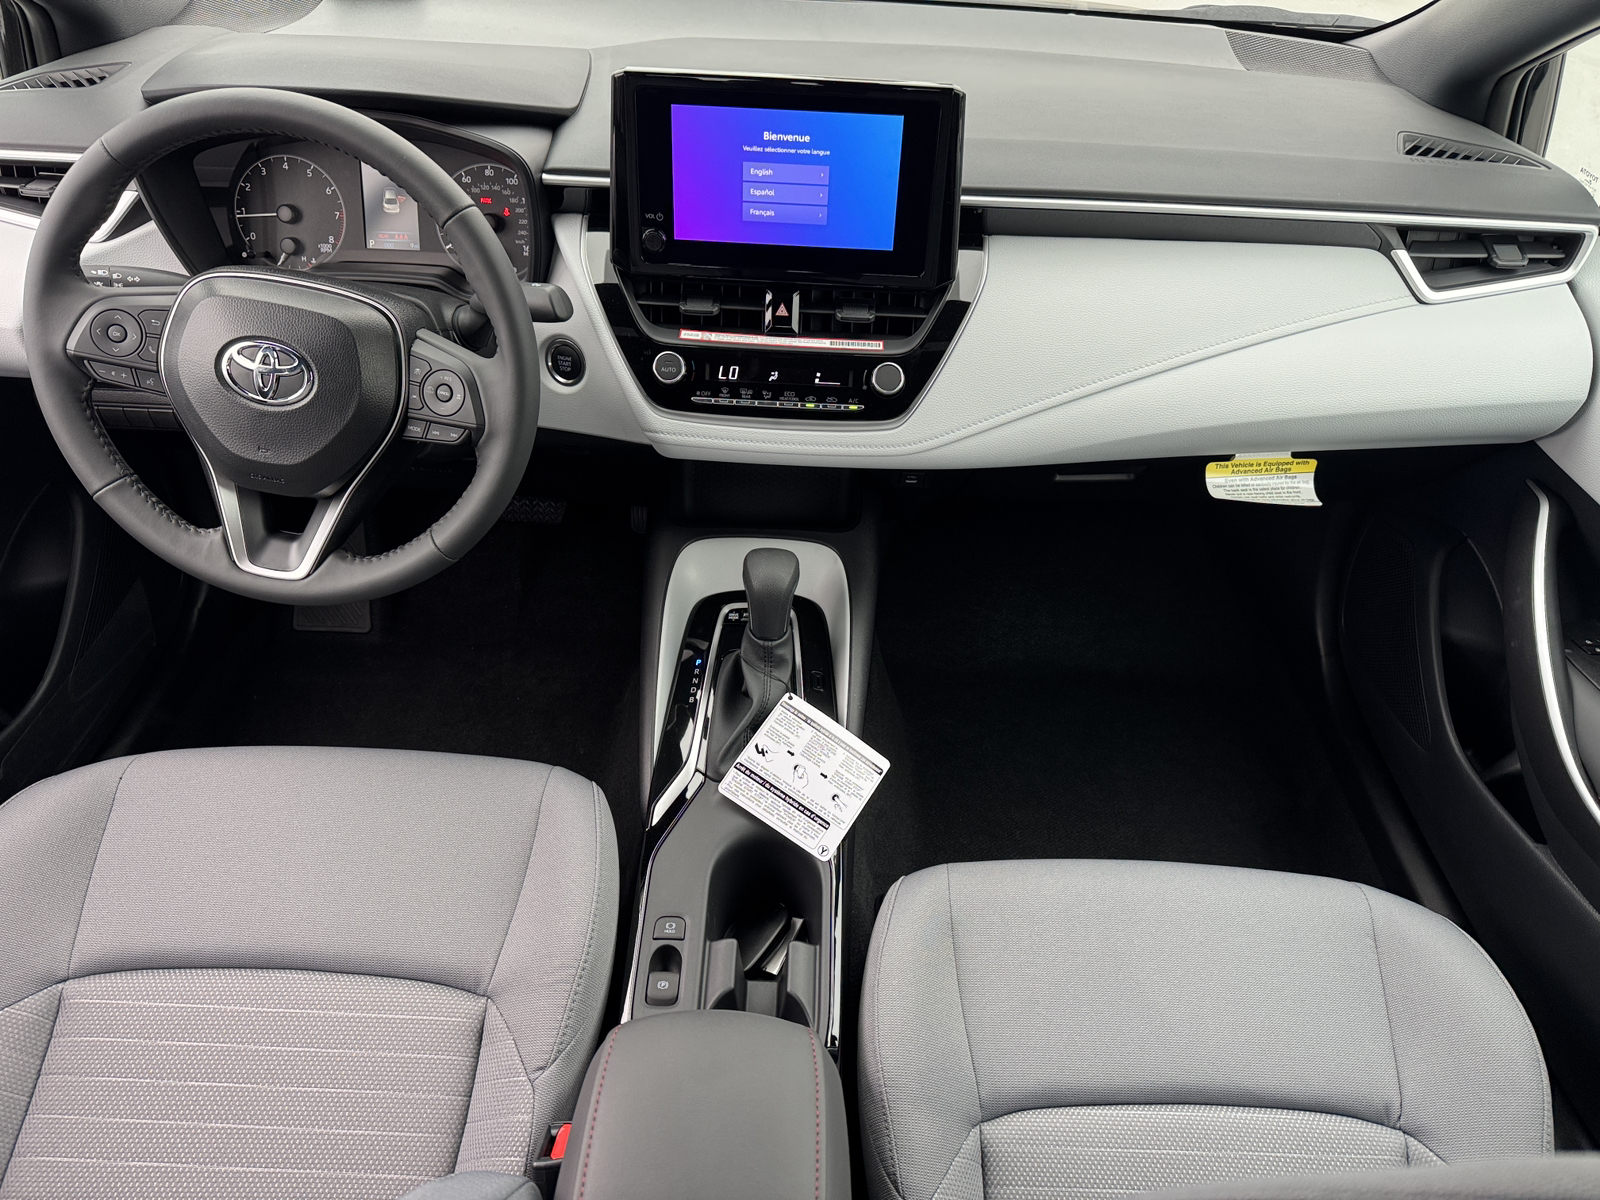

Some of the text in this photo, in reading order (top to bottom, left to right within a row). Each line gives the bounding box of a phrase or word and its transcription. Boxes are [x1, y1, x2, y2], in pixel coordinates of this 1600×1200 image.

[764, 132, 810, 142] Bienvenue
[282, 162, 289, 170] 4
[306, 169, 312, 177] 5
[750, 168, 773, 176] English
[245, 183, 251, 191] 2
[326, 186, 331, 195] 6
[750, 209, 774, 217] Français
